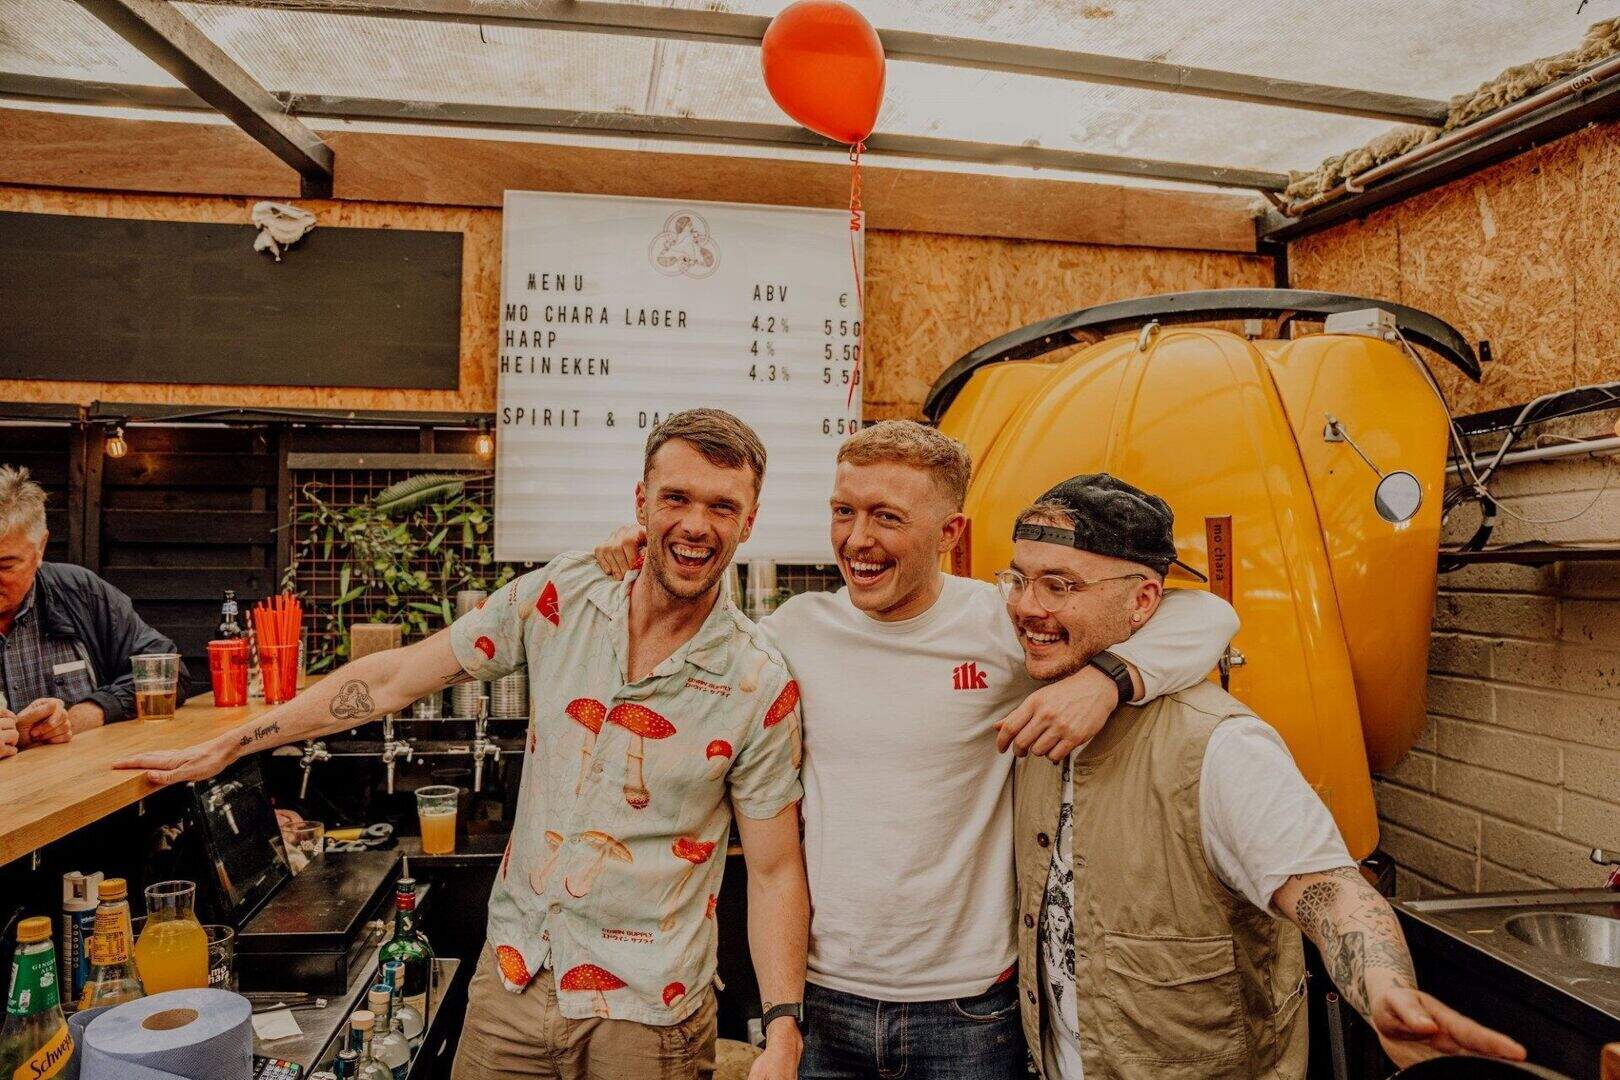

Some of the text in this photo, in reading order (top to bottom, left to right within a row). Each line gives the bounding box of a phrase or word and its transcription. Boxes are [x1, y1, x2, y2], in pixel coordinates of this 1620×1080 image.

[527, 273, 847, 308] MENU ABV €
[505, 304, 528, 322] MO
[545, 305, 608, 325] CHARA
[625, 308, 686, 328] LAGER
[506, 330, 556, 348] HARP
[825, 344, 861, 361] 5.50
[503, 407, 580, 427] SPIRIT
[606, 412, 615, 427] &
[1214, 525, 1225, 581] mo chara
[953, 662, 988, 690] ilk
